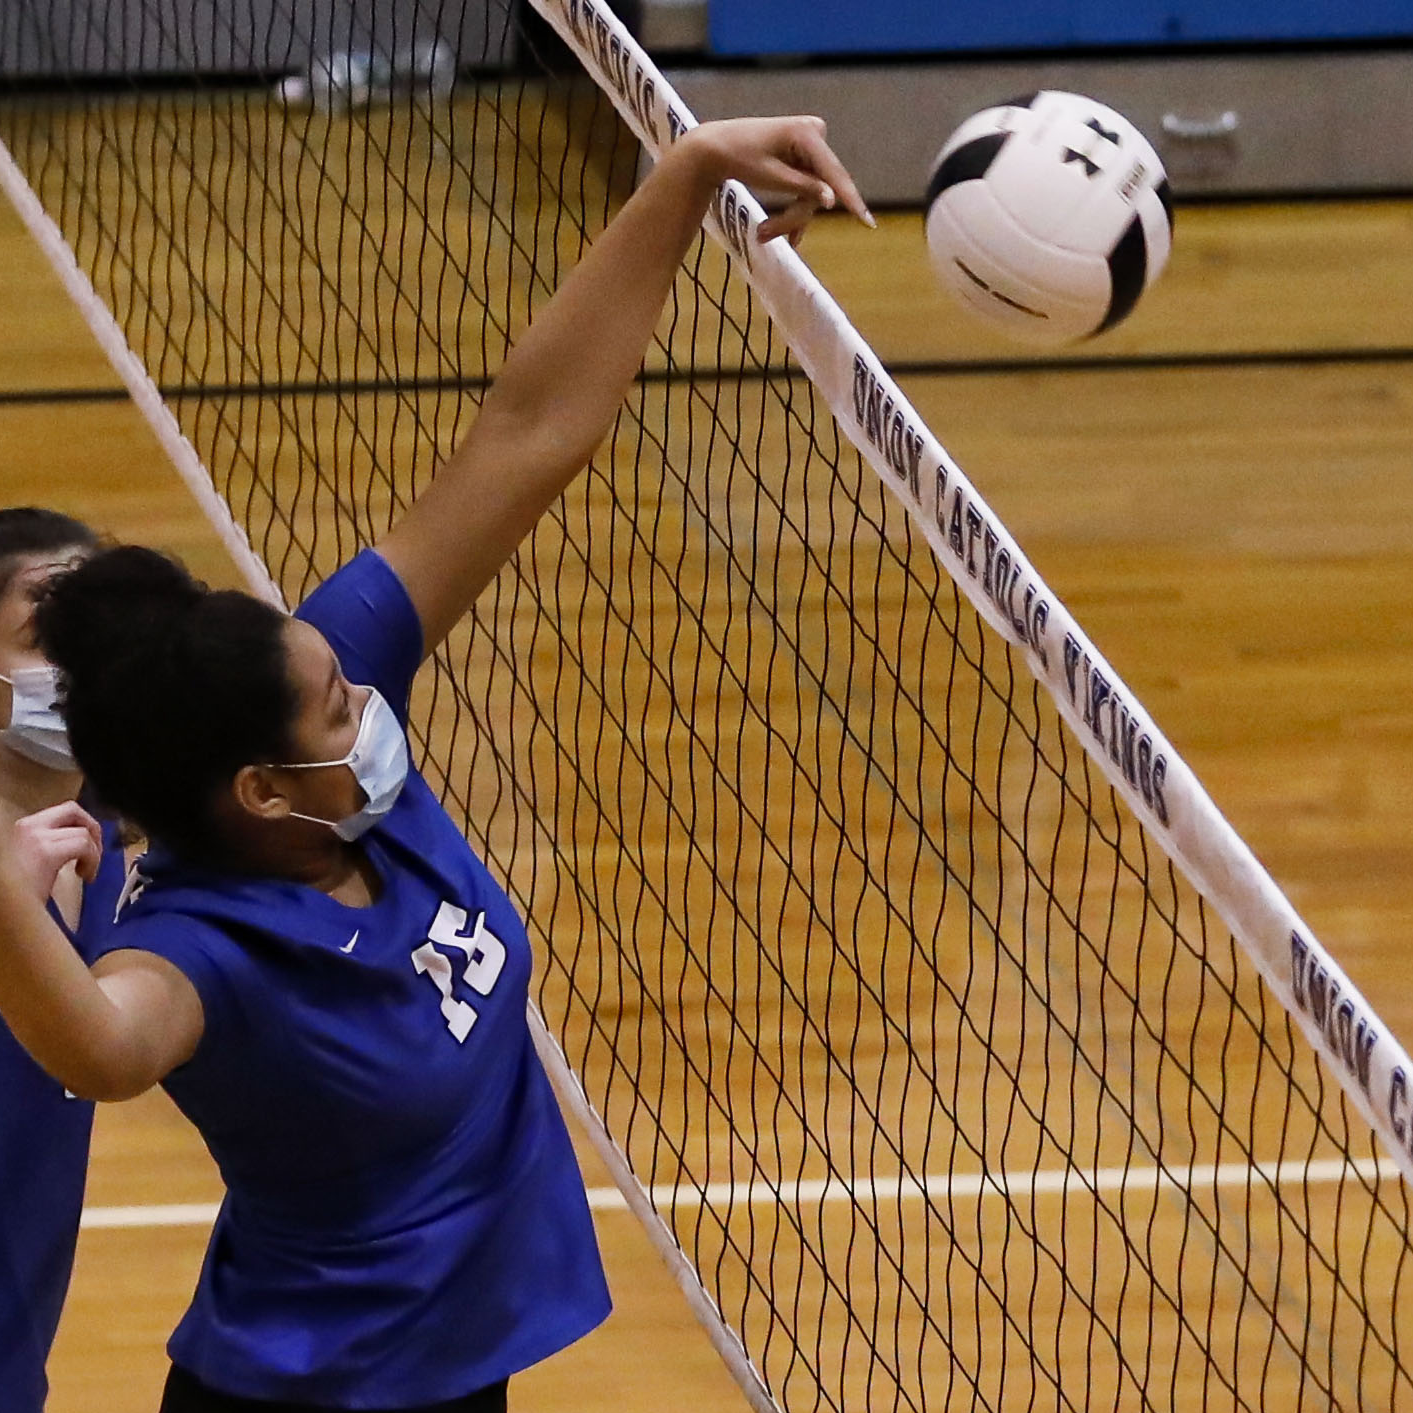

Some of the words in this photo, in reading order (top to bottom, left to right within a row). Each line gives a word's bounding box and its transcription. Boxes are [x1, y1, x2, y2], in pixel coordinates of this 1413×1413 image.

[852, 352, 924, 507] UNION
[936, 464, 1050, 674] CATHOLIC
[1063, 631, 1170, 830] VIKINGS
[410, 900, 507, 1045] 15
[1290, 929, 1378, 1102] UNION
